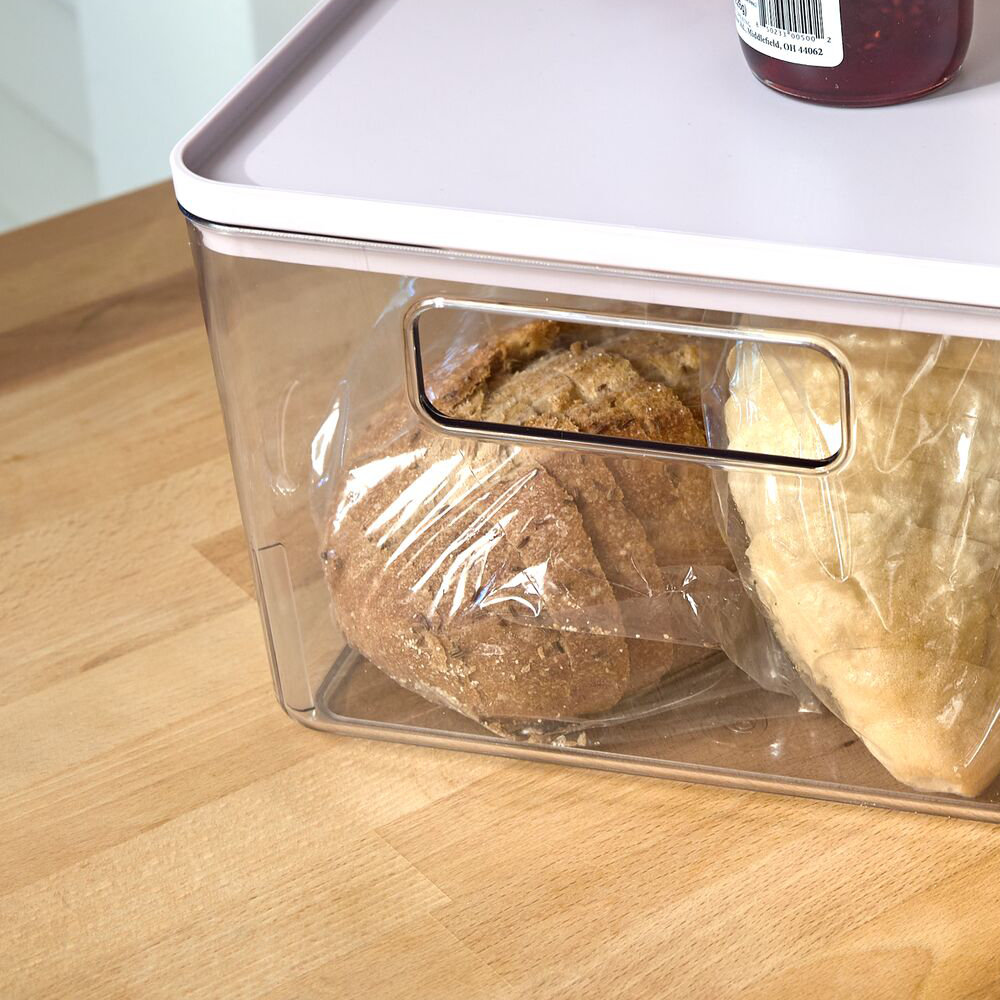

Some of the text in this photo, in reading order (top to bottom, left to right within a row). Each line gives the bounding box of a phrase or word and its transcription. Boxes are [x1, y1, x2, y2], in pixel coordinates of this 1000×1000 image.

[791, 33, 816, 43] 00500
[826, 36, 832, 44] 2
[783, 43, 796, 53] OH
[798, 46, 824, 56] 44062
